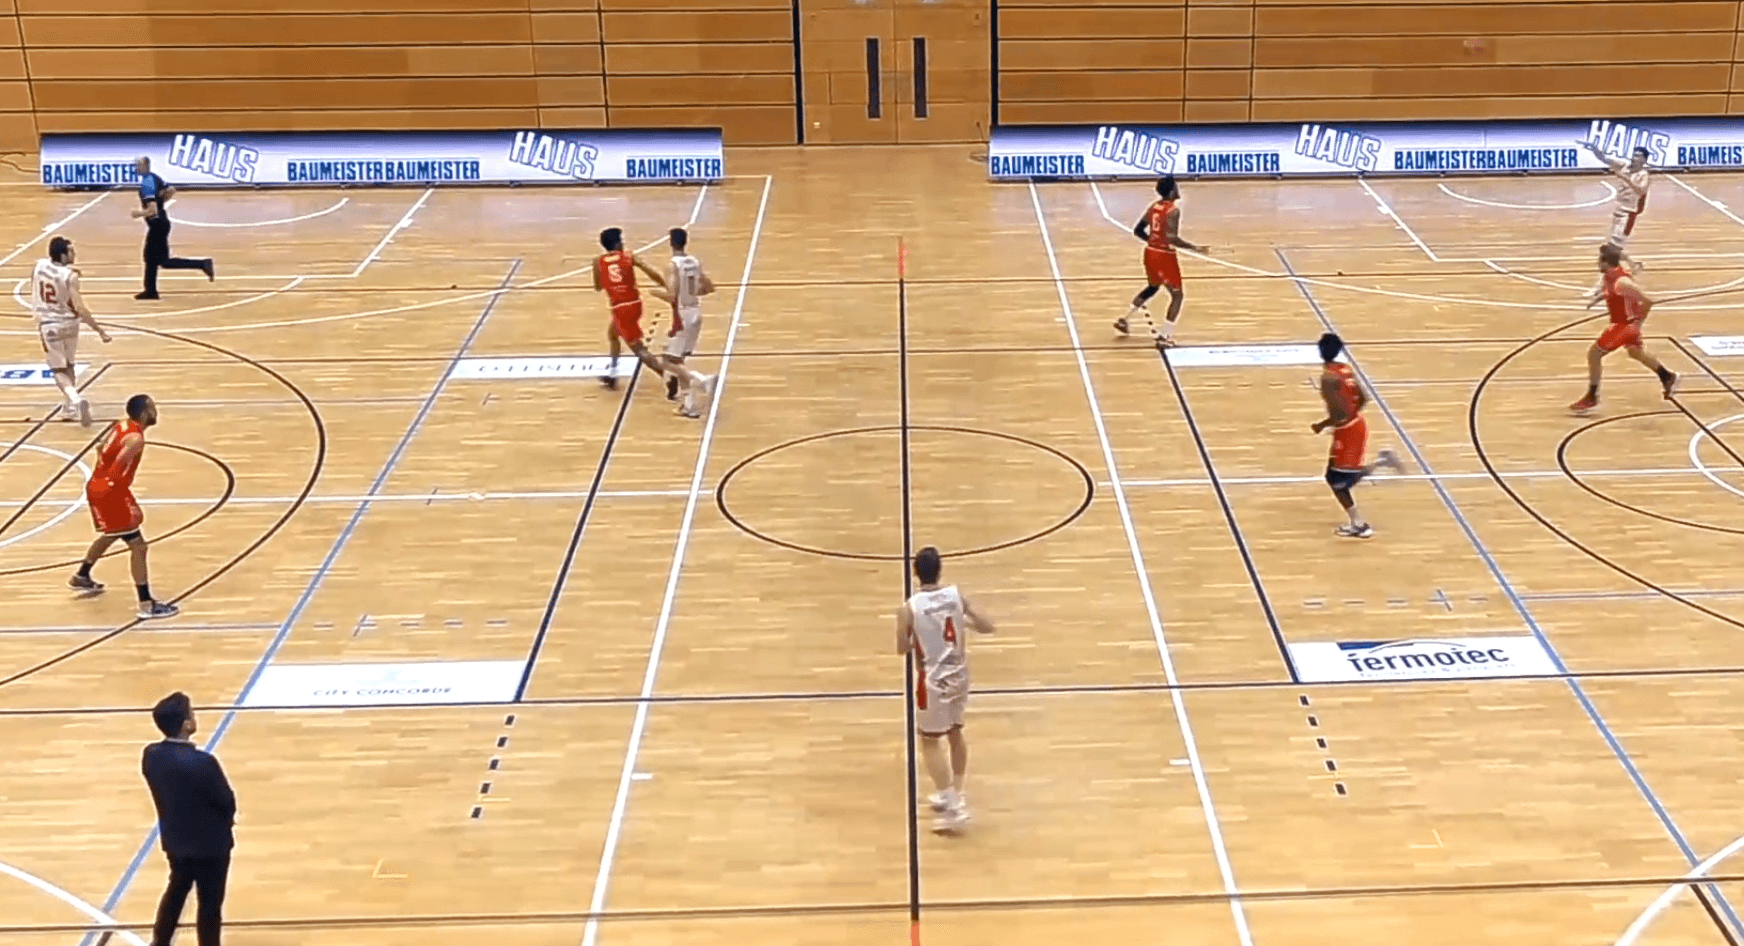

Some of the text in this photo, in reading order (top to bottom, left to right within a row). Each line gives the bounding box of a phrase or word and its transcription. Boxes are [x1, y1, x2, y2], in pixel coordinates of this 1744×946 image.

[169, 133, 260, 183] HAUS
[509, 130, 599, 180] HAUS
[1092, 125, 1180, 175] HAUS
[1295, 123, 1381, 171] HAUS
[42, 163, 138, 184] BAUMEISTER
[626, 158, 721, 179] BAUMEISTER
[991, 154, 1085, 175] BAUMEISTER
[1186, 152, 1280, 173] BAUMEISTER
[39, 281, 57, 304] 12
[943, 616, 957, 646] 4
